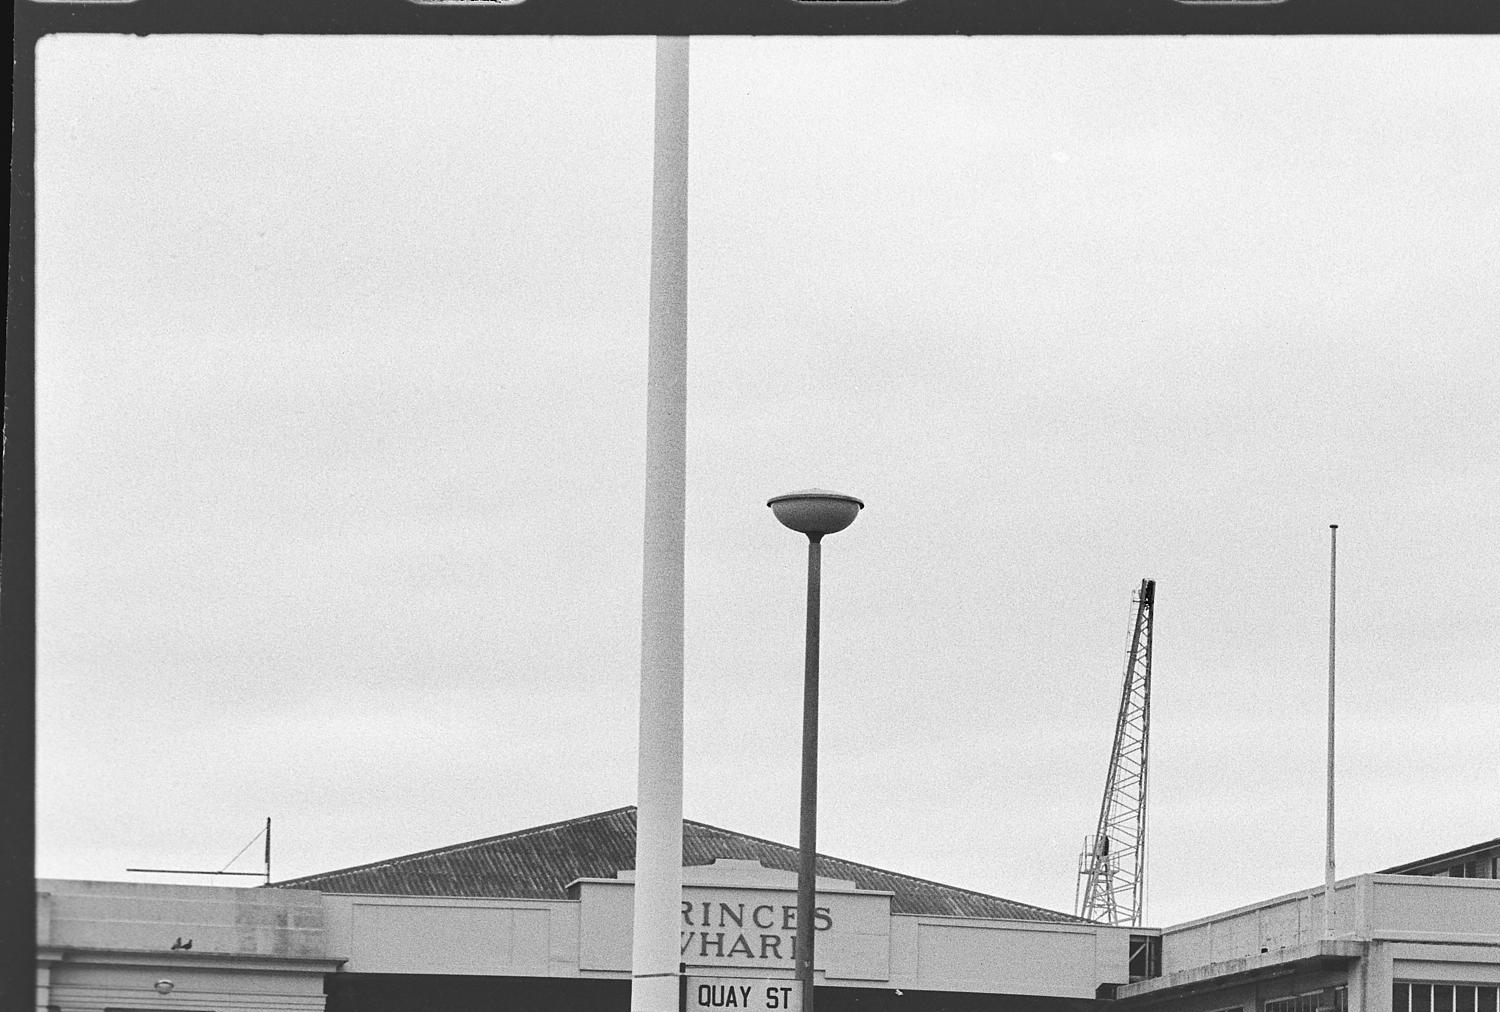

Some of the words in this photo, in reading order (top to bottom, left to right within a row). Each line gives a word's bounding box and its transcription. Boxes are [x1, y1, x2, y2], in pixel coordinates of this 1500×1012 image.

[681, 901, 833, 931] RINCES
[698, 984, 751, 1008] QUAY
[766, 986, 792, 1009] ST
